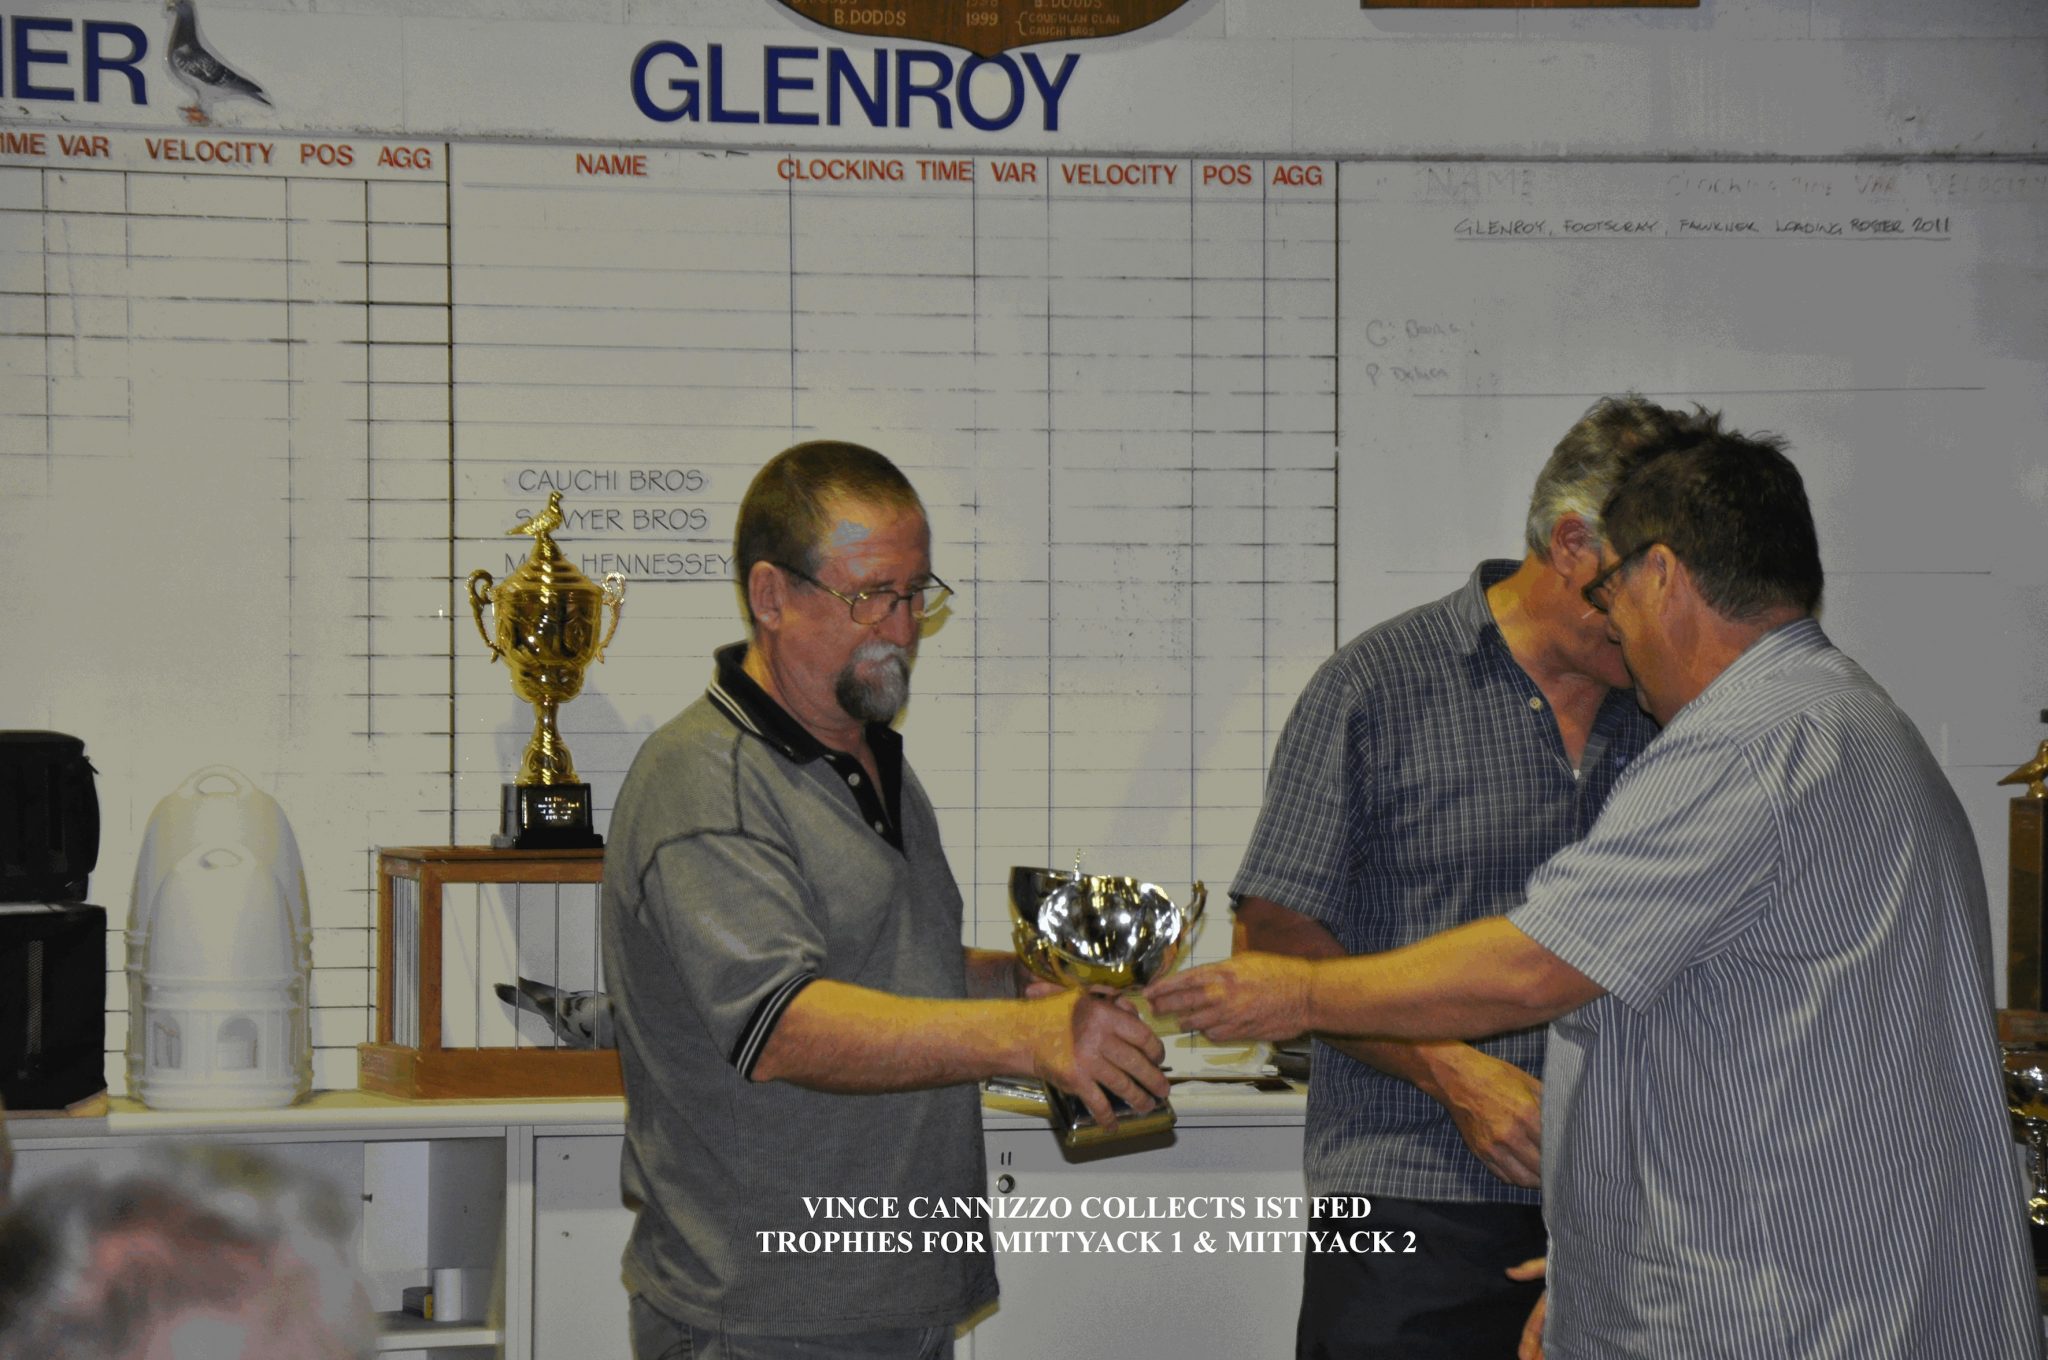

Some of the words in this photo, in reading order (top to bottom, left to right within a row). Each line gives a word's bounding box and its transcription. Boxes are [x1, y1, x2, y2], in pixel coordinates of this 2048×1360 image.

[966, 12, 999, 27] 1999
[0, 15, 148, 107] ER
[630, 40, 1081, 131] GLENROY
[57, 134, 110, 158] VAR
[145, 137, 274, 166] VELOCITY
[300, 143, 354, 167] POS
[377, 146, 432, 169] AGG
[576, 153, 649, 177] NAME
[777, 158, 904, 182] CLOCKING
[915, 160, 974, 182] TIME
[990, 162, 1037, 184] VAR
[1060, 164, 1179, 187] VELOCITY
[1203, 165, 1253, 187] POS
[1271, 166, 1323, 187] AGG
[1911, 216, 1951, 234] 2011
[518, 469, 618, 492] CAUCHI
[629, 469, 704, 493] BROS
[633, 508, 708, 532] BROS
[582, 553, 734, 576] HENNESSEY
